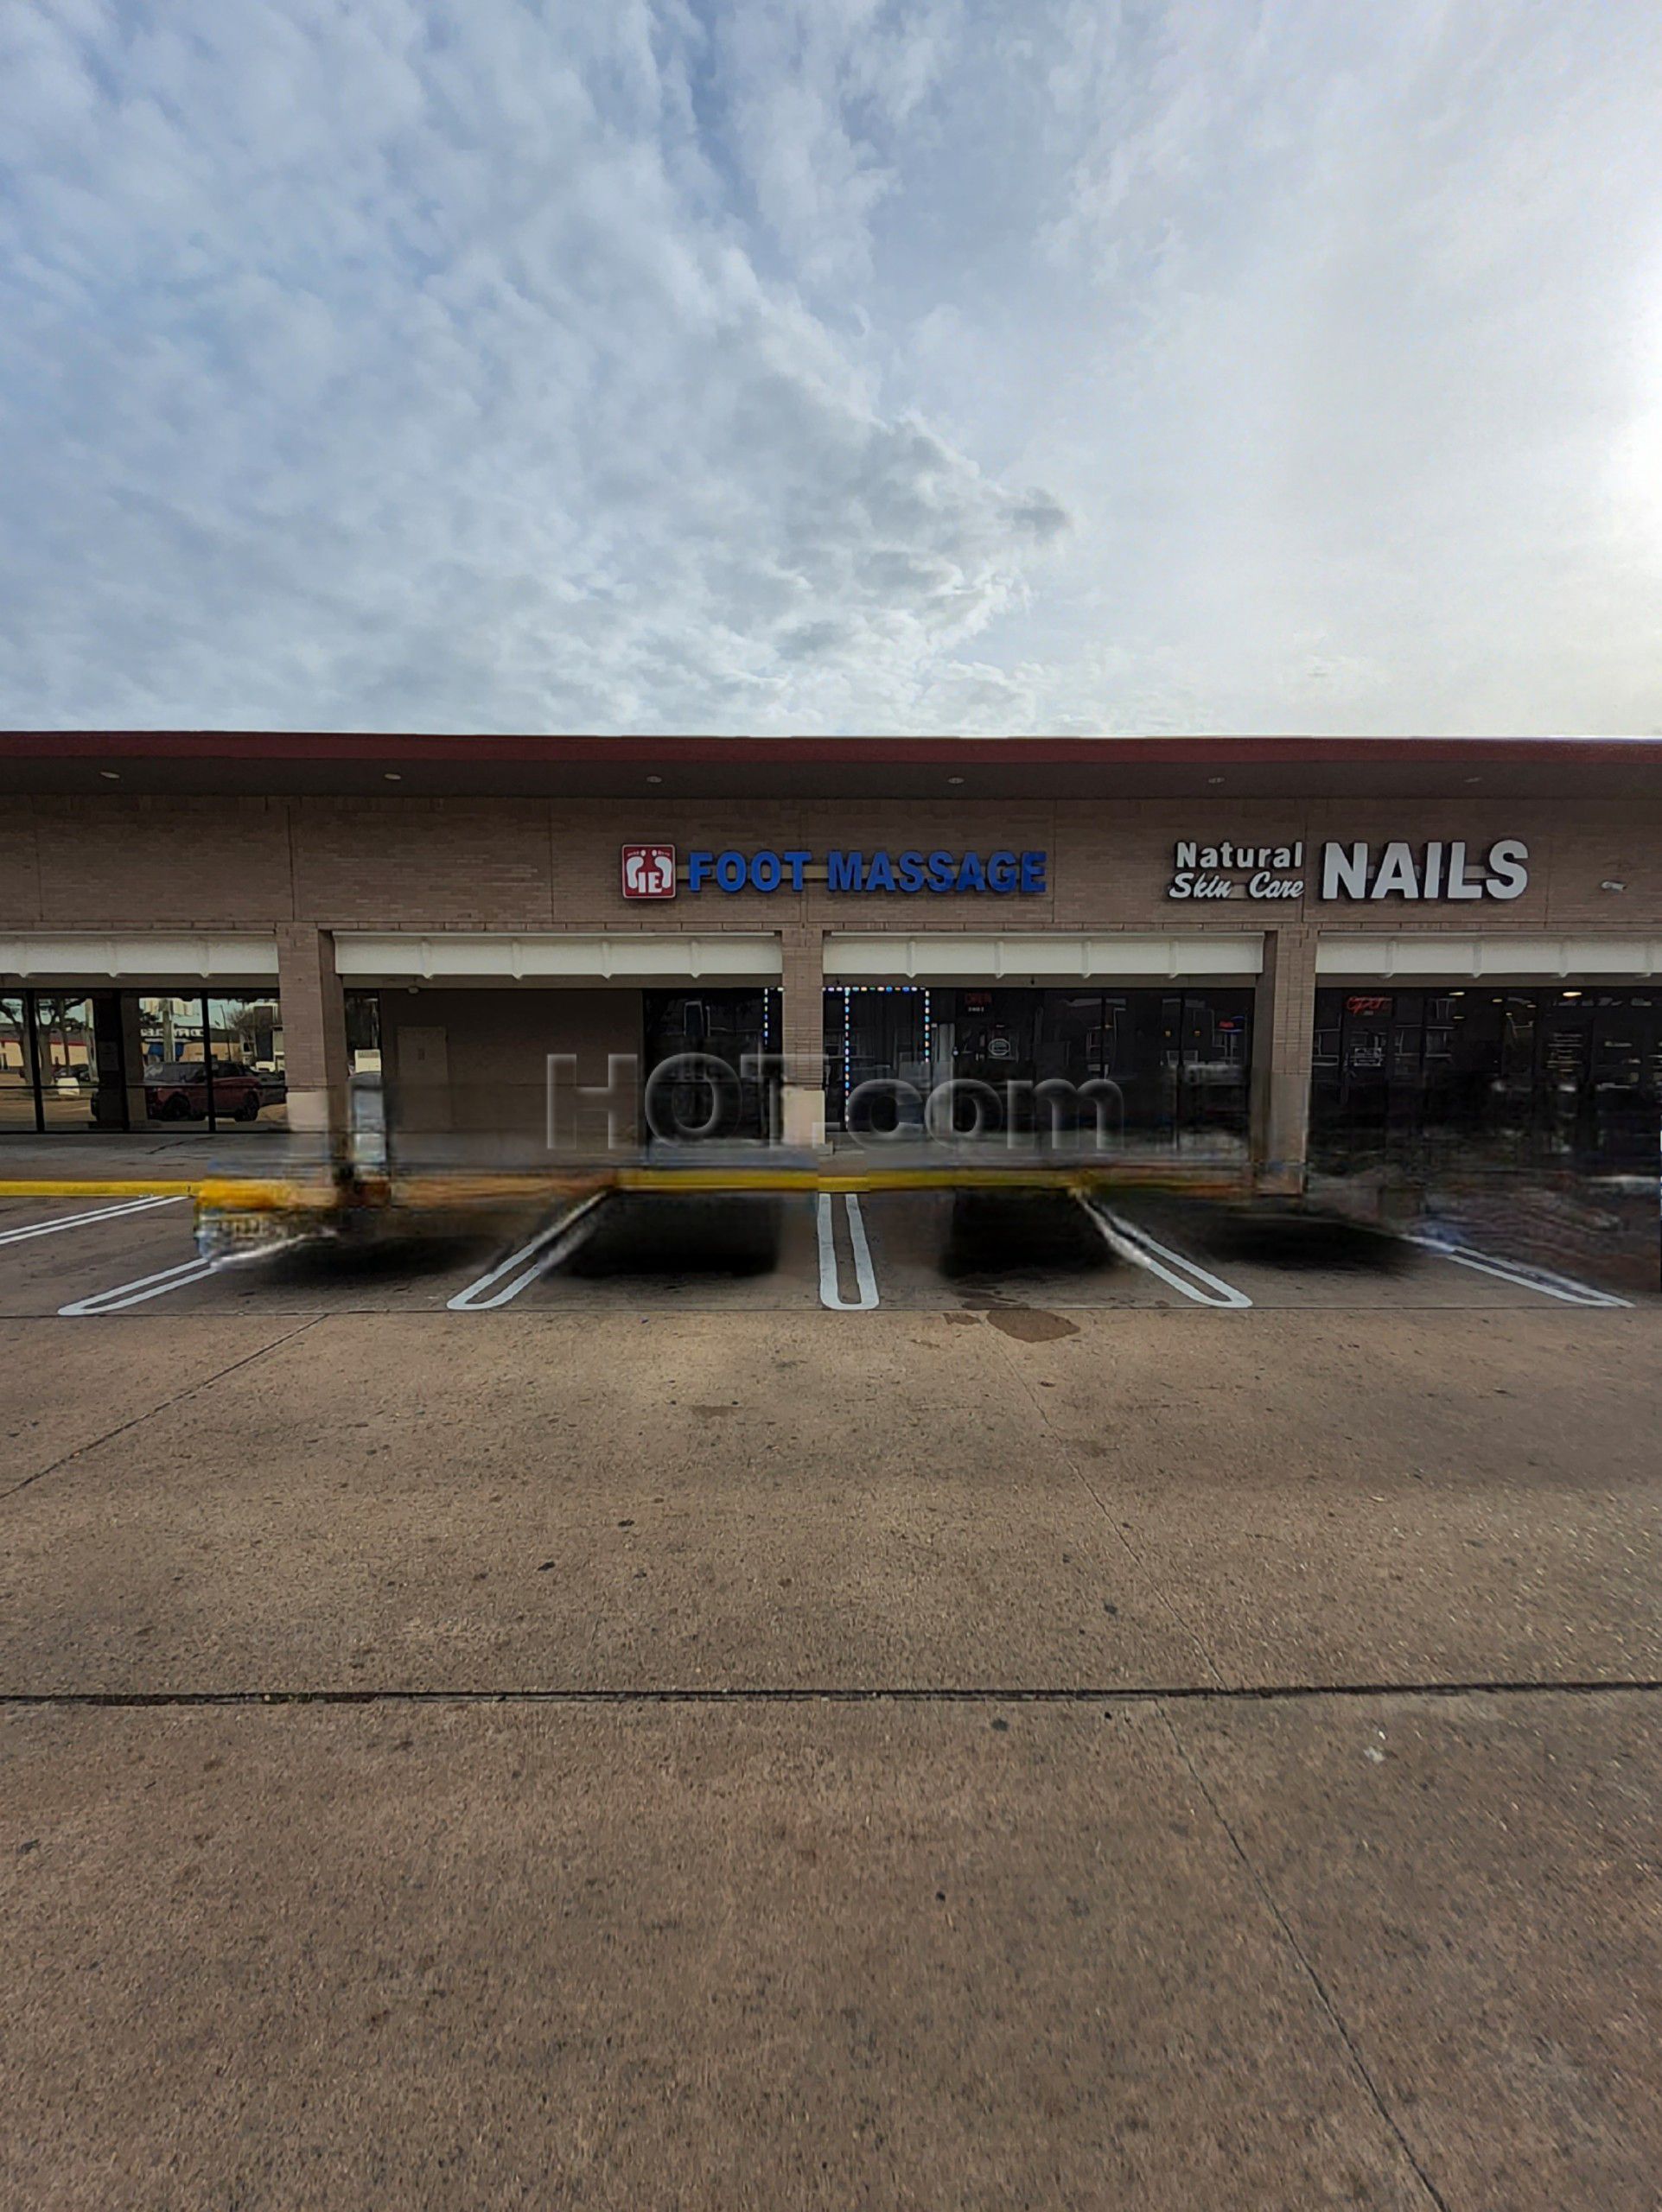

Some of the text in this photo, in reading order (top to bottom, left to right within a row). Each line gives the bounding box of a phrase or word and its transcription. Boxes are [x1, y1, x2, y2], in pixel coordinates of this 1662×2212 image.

[688, 850, 1047, 893] FOOT MASSAGE
[1176, 842, 1302, 868] Natural
[1322, 839, 1528, 899] NAILS
[1169, 871, 1305, 898] Skin Care
